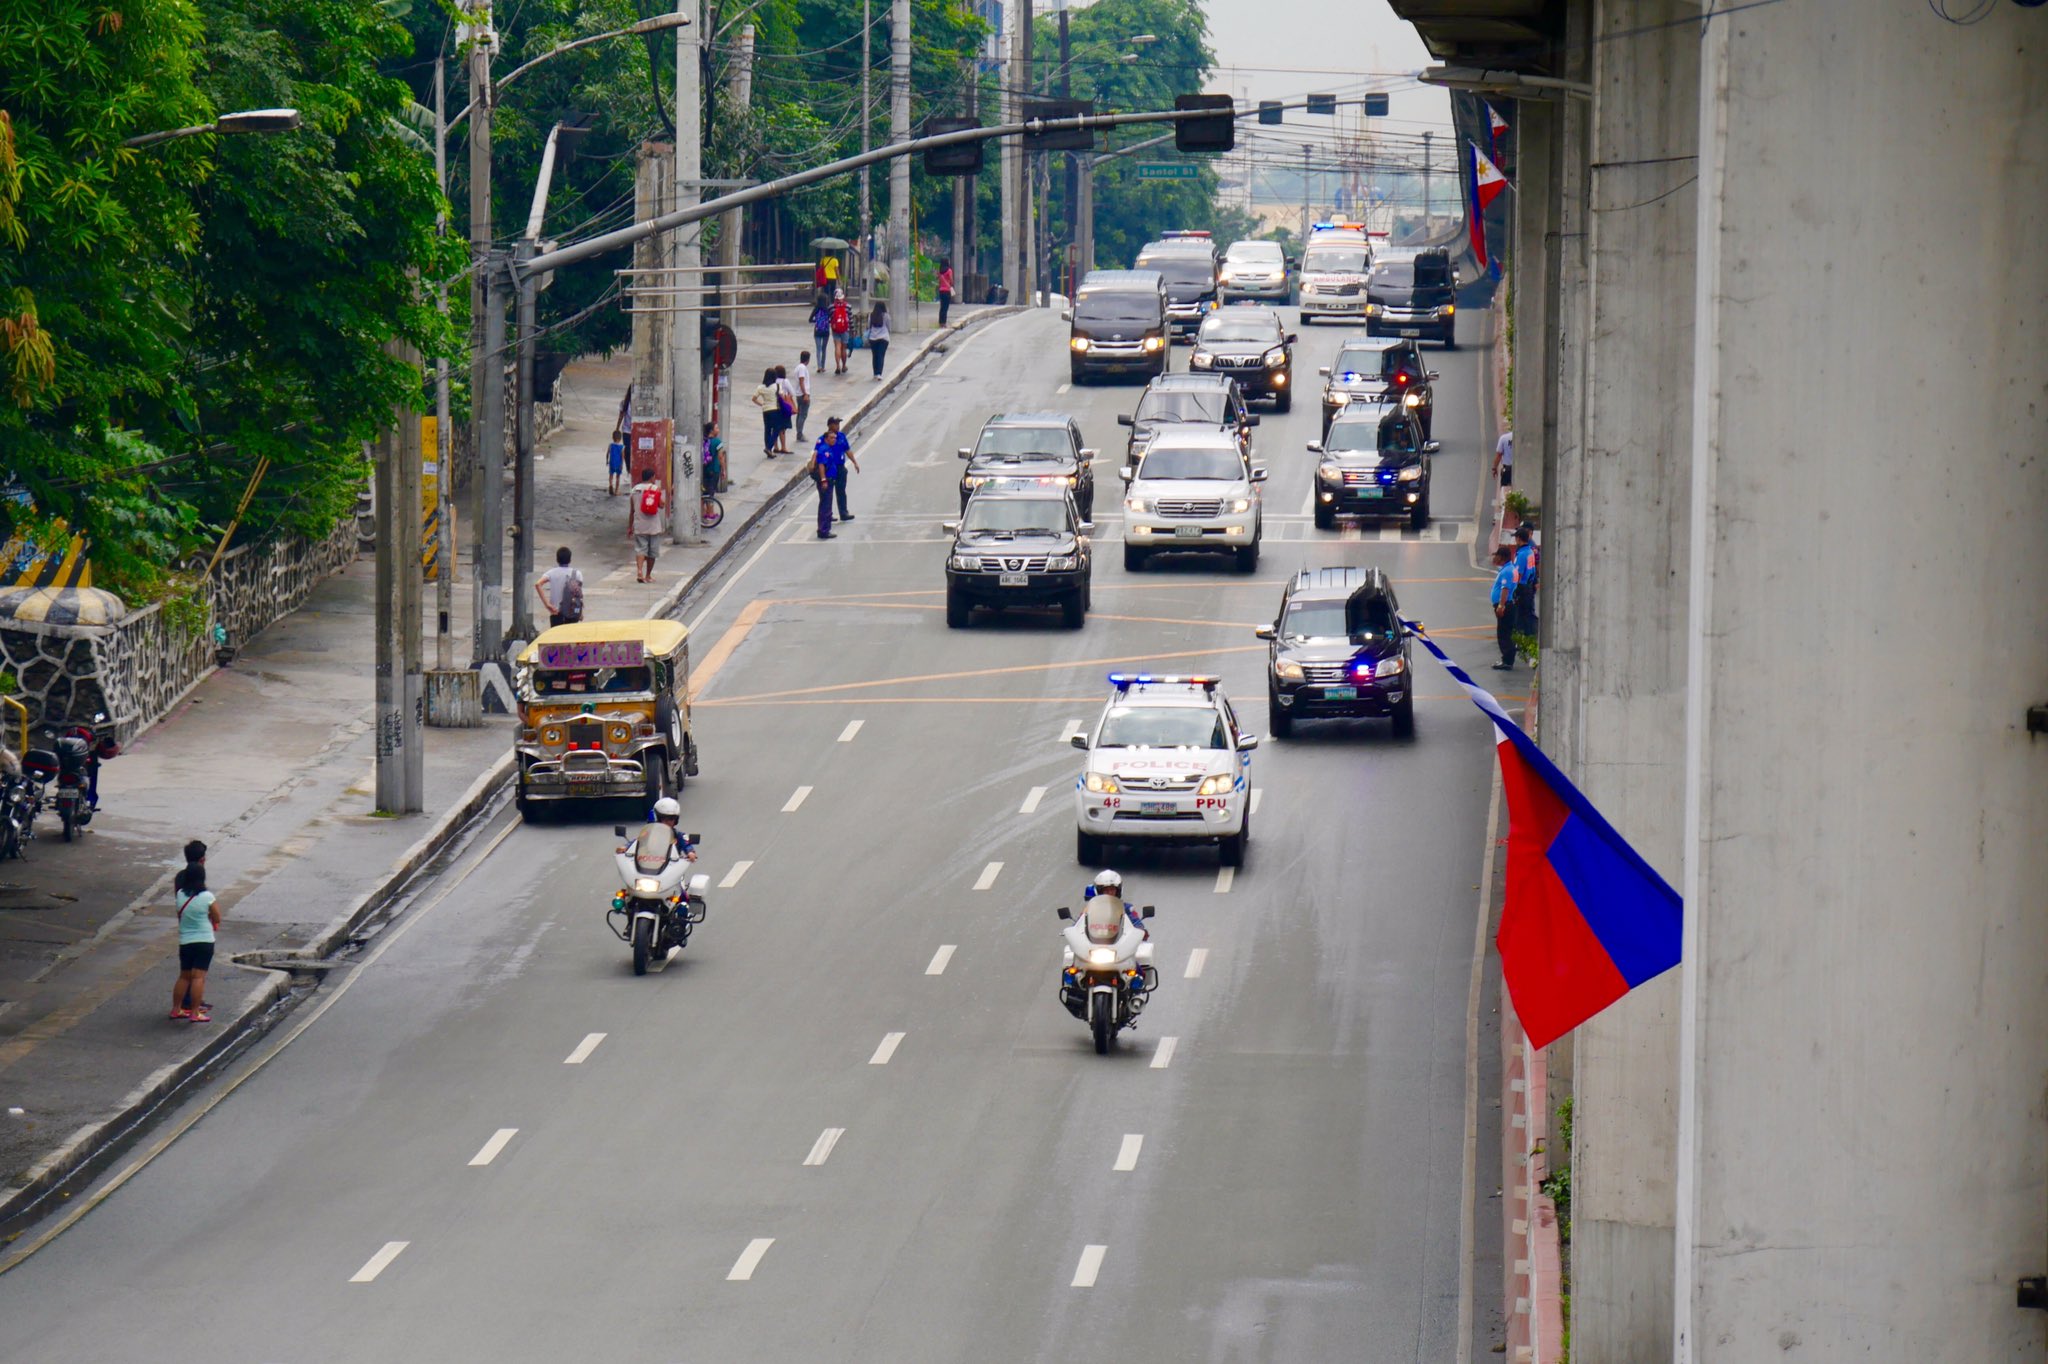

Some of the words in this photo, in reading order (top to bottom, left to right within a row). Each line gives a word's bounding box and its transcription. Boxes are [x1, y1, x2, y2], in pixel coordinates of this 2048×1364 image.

[1142, 167, 1177, 176] Santol
[1112, 760, 1208, 771] POLICE
[1103, 797, 1121, 808] 48
[1196, 798, 1227, 809] PPU
[1090, 923, 1118, 932] POLICE
